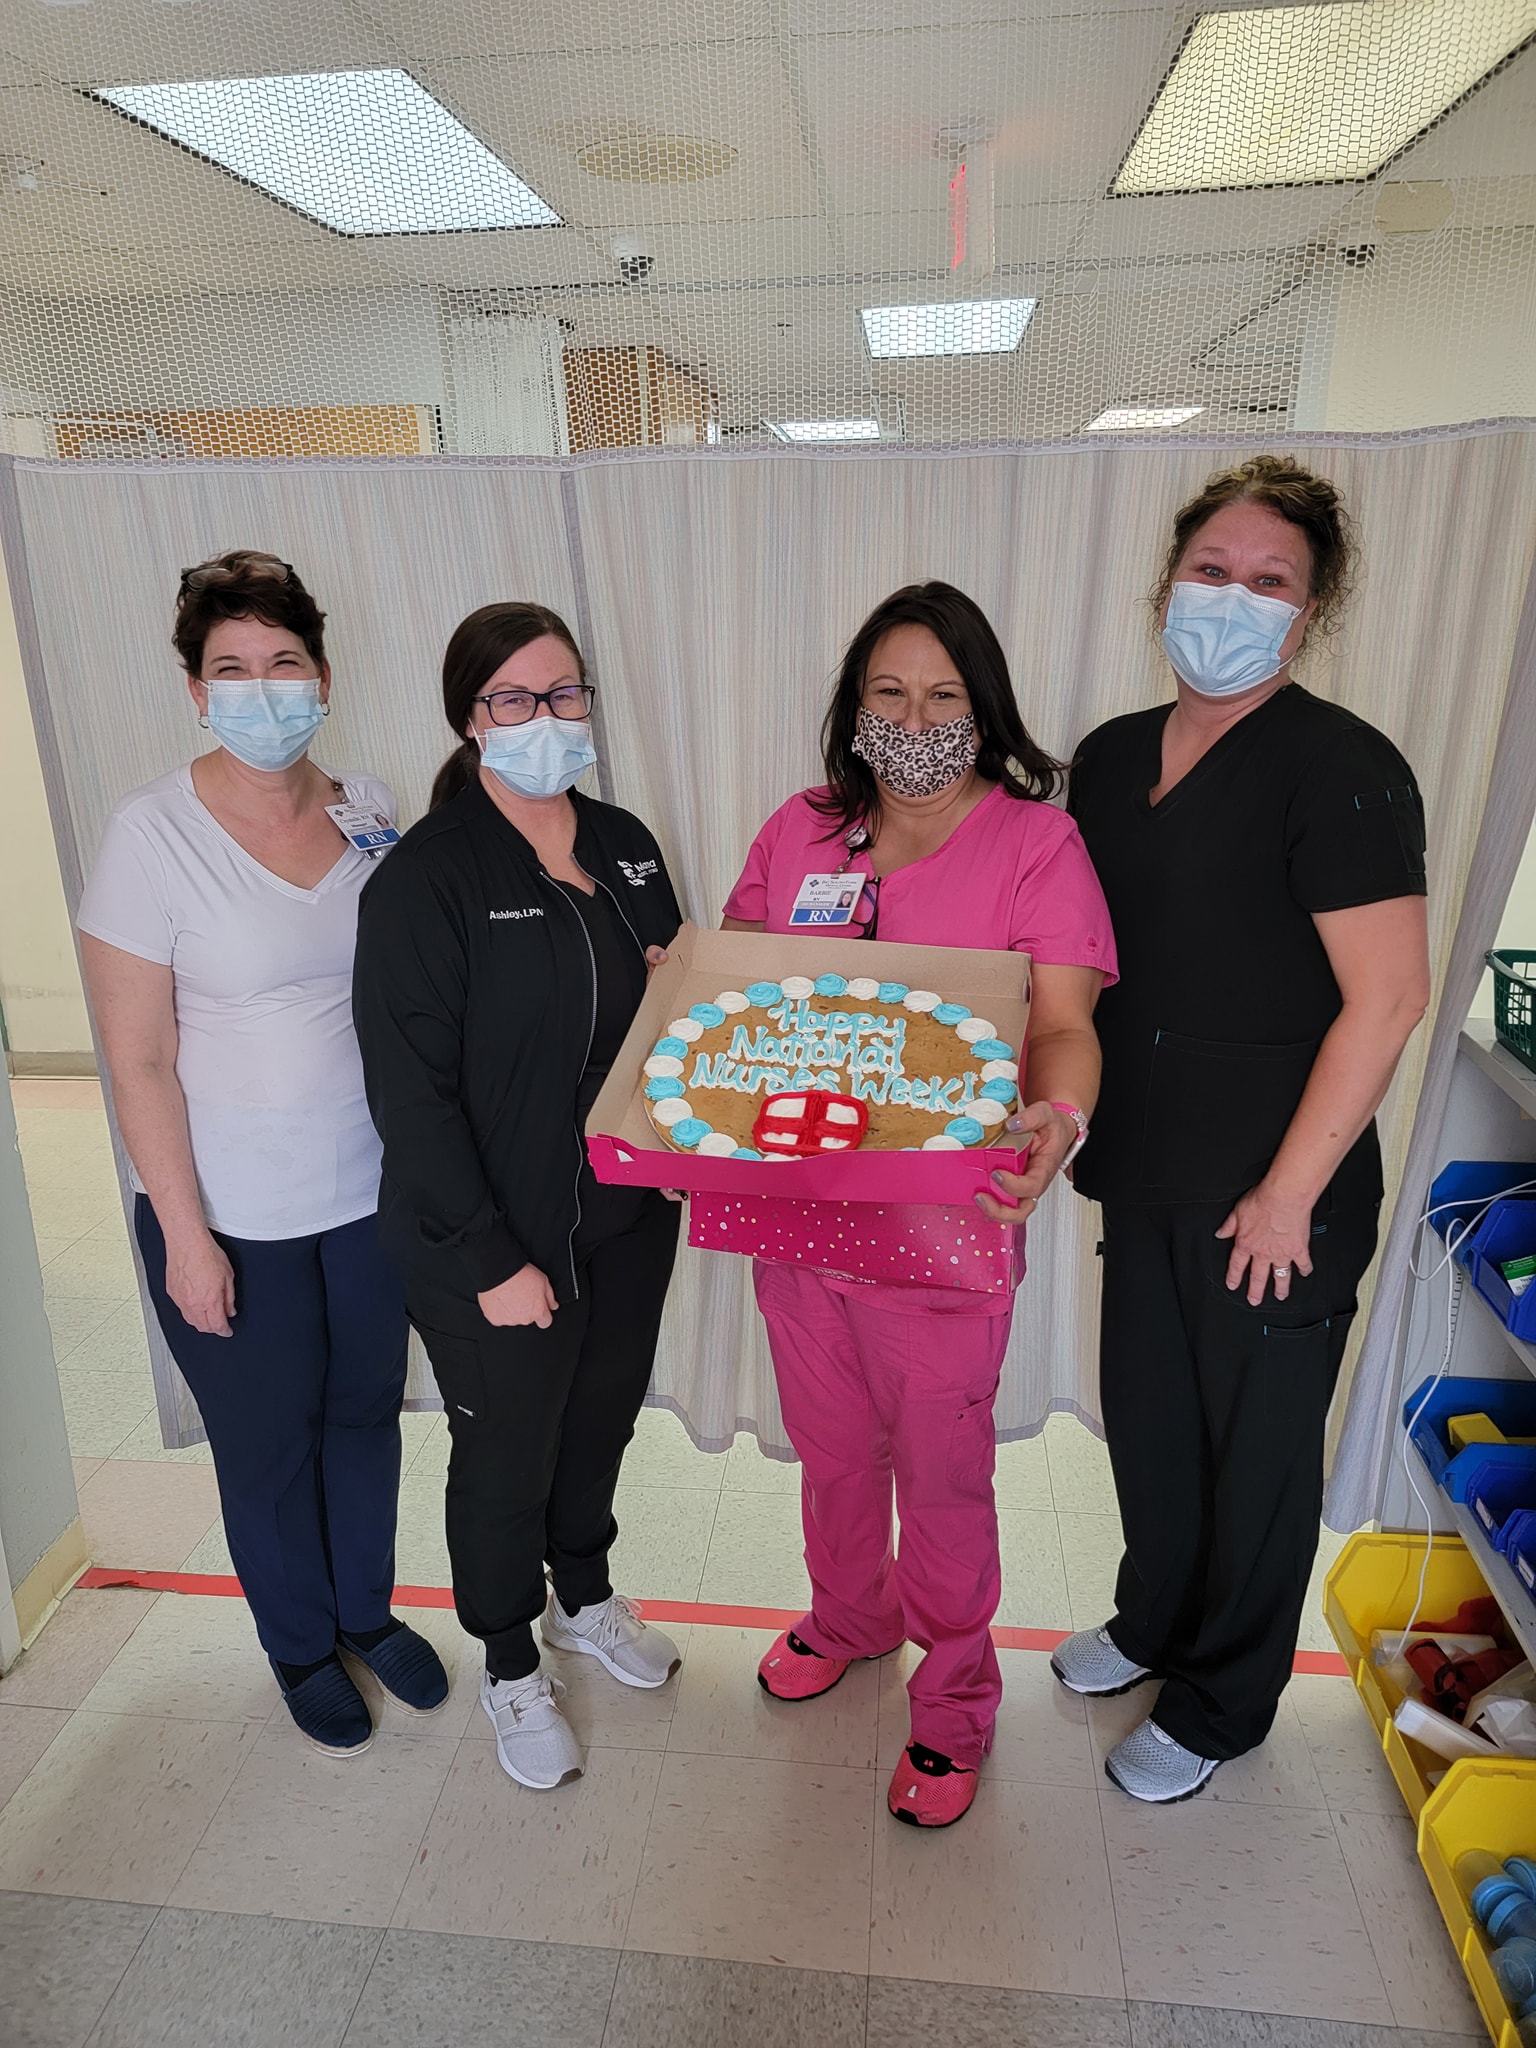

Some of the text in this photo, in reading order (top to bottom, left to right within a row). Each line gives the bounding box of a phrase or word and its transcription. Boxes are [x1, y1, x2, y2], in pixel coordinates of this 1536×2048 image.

[365, 832, 388, 844] RN
[807, 910, 834, 921] RN
[768, 1000, 907, 1042] Happy
[728, 1024, 906, 1074] National
[689, 1052, 978, 1115] Nurses Week!
